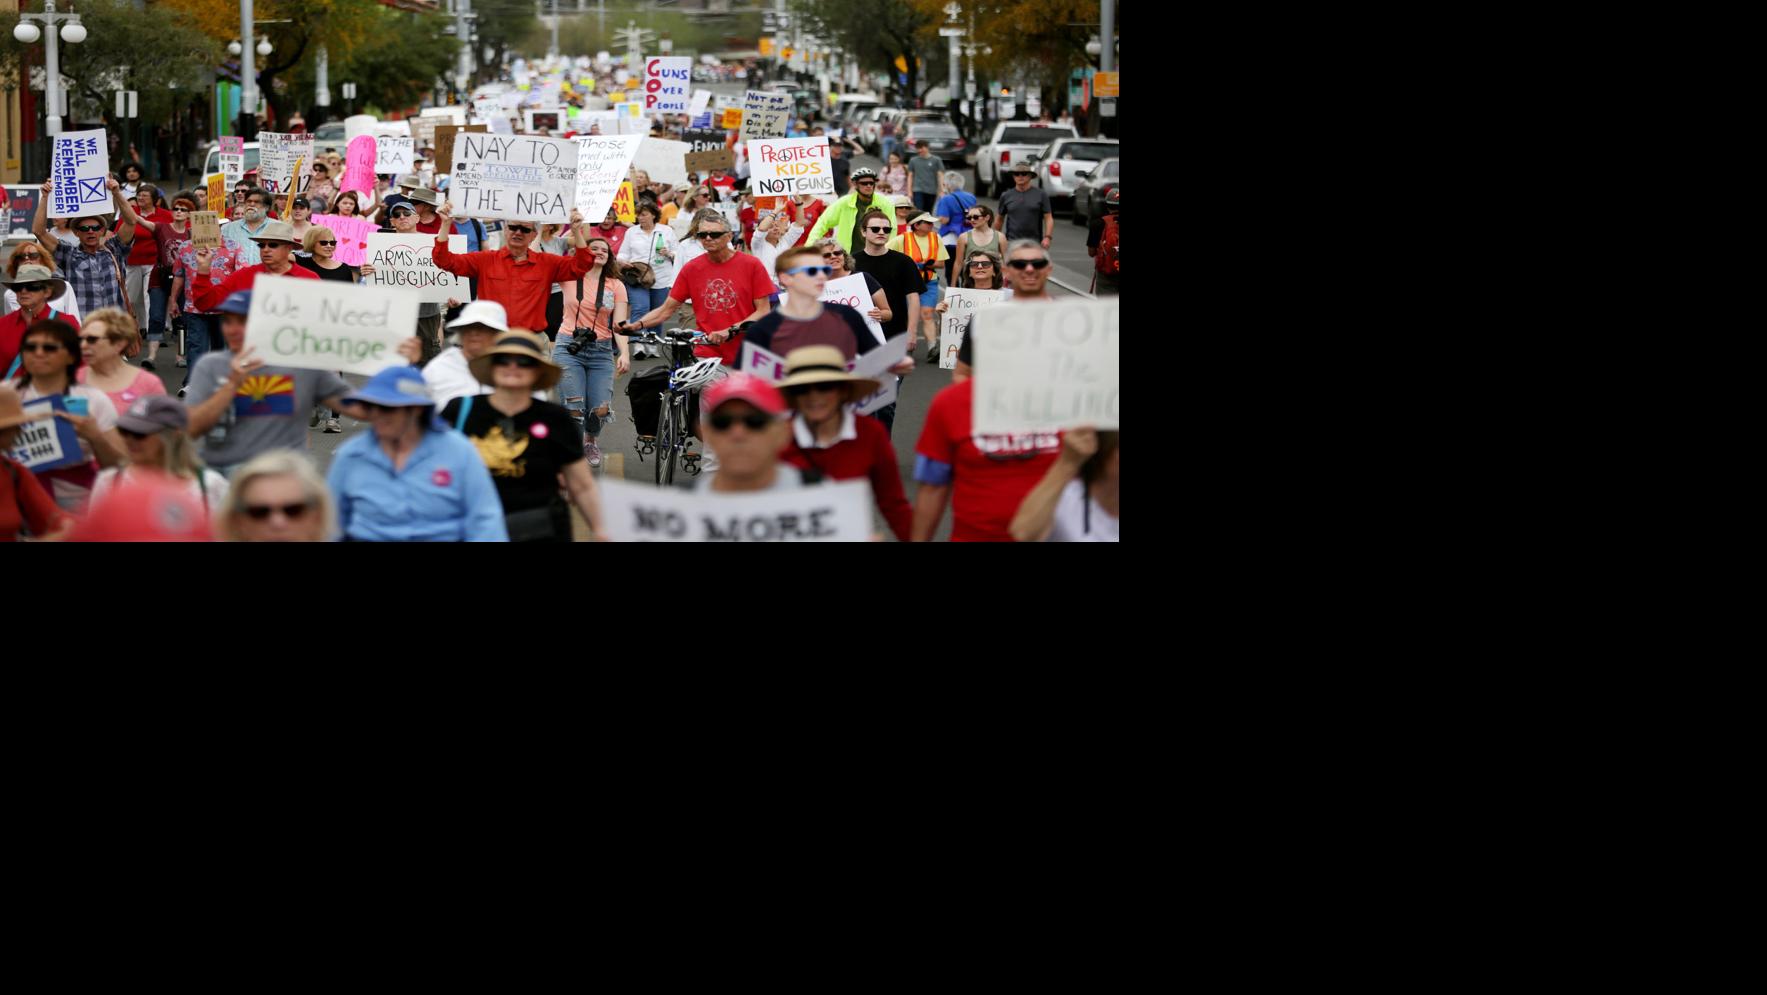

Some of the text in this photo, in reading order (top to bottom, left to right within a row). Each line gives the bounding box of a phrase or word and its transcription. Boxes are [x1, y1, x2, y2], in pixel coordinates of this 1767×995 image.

[647, 59, 688, 80] GUNS
[646, 79, 683, 96] OVER
[646, 94, 684, 110] PEOPLE
[73, 139, 87, 167] WILL
[86, 137, 98, 156] WE
[464, 136, 516, 162] NAY
[526, 140, 560, 166] TO
[579, 138, 627, 150] Those
[760, 144, 830, 163] PROTECT
[61, 139, 80, 213] REMEMBER
[775, 162, 823, 177] KIDS
[759, 176, 833, 195] NOT GUNS
[459, 186, 567, 217] THE NRA
[373, 250, 413, 267] ARMS
[319, 298, 391, 328] Need
[271, 325, 387, 364] Change
[632, 505, 838, 541] NO MORE
